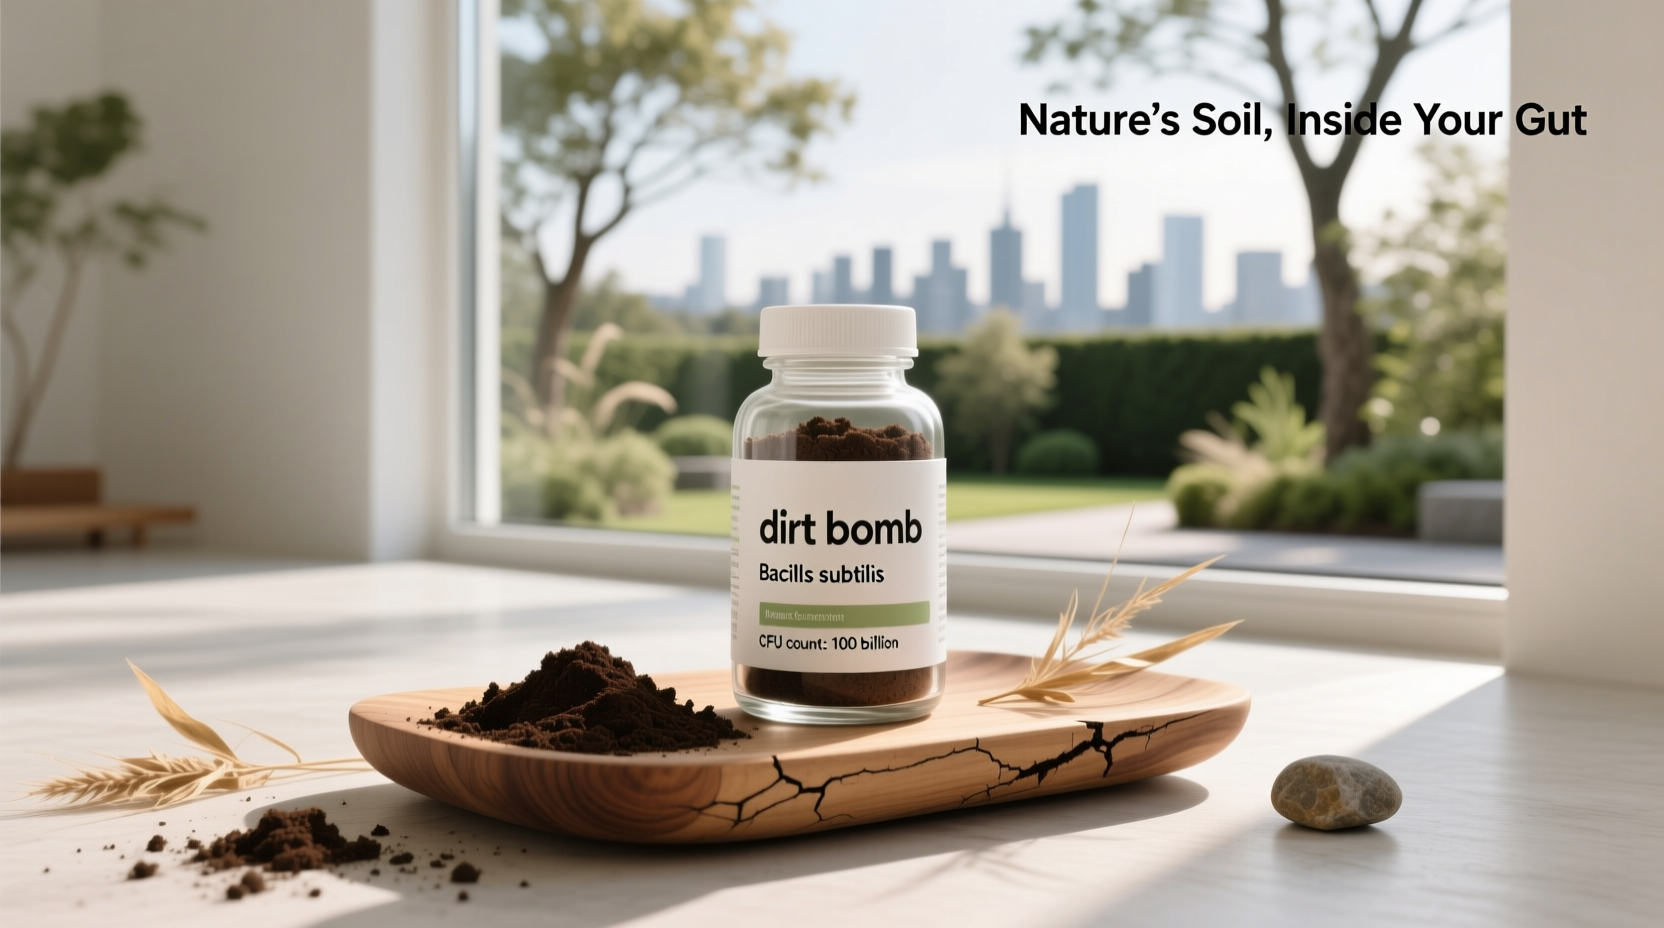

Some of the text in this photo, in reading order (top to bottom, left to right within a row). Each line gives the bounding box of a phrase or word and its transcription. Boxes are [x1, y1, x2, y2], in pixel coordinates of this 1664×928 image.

[759, 508, 923, 546] dirt bomb
[759, 562, 885, 584] Bacills subtilis
[759, 634, 899, 651] CFU count: 100 billion
